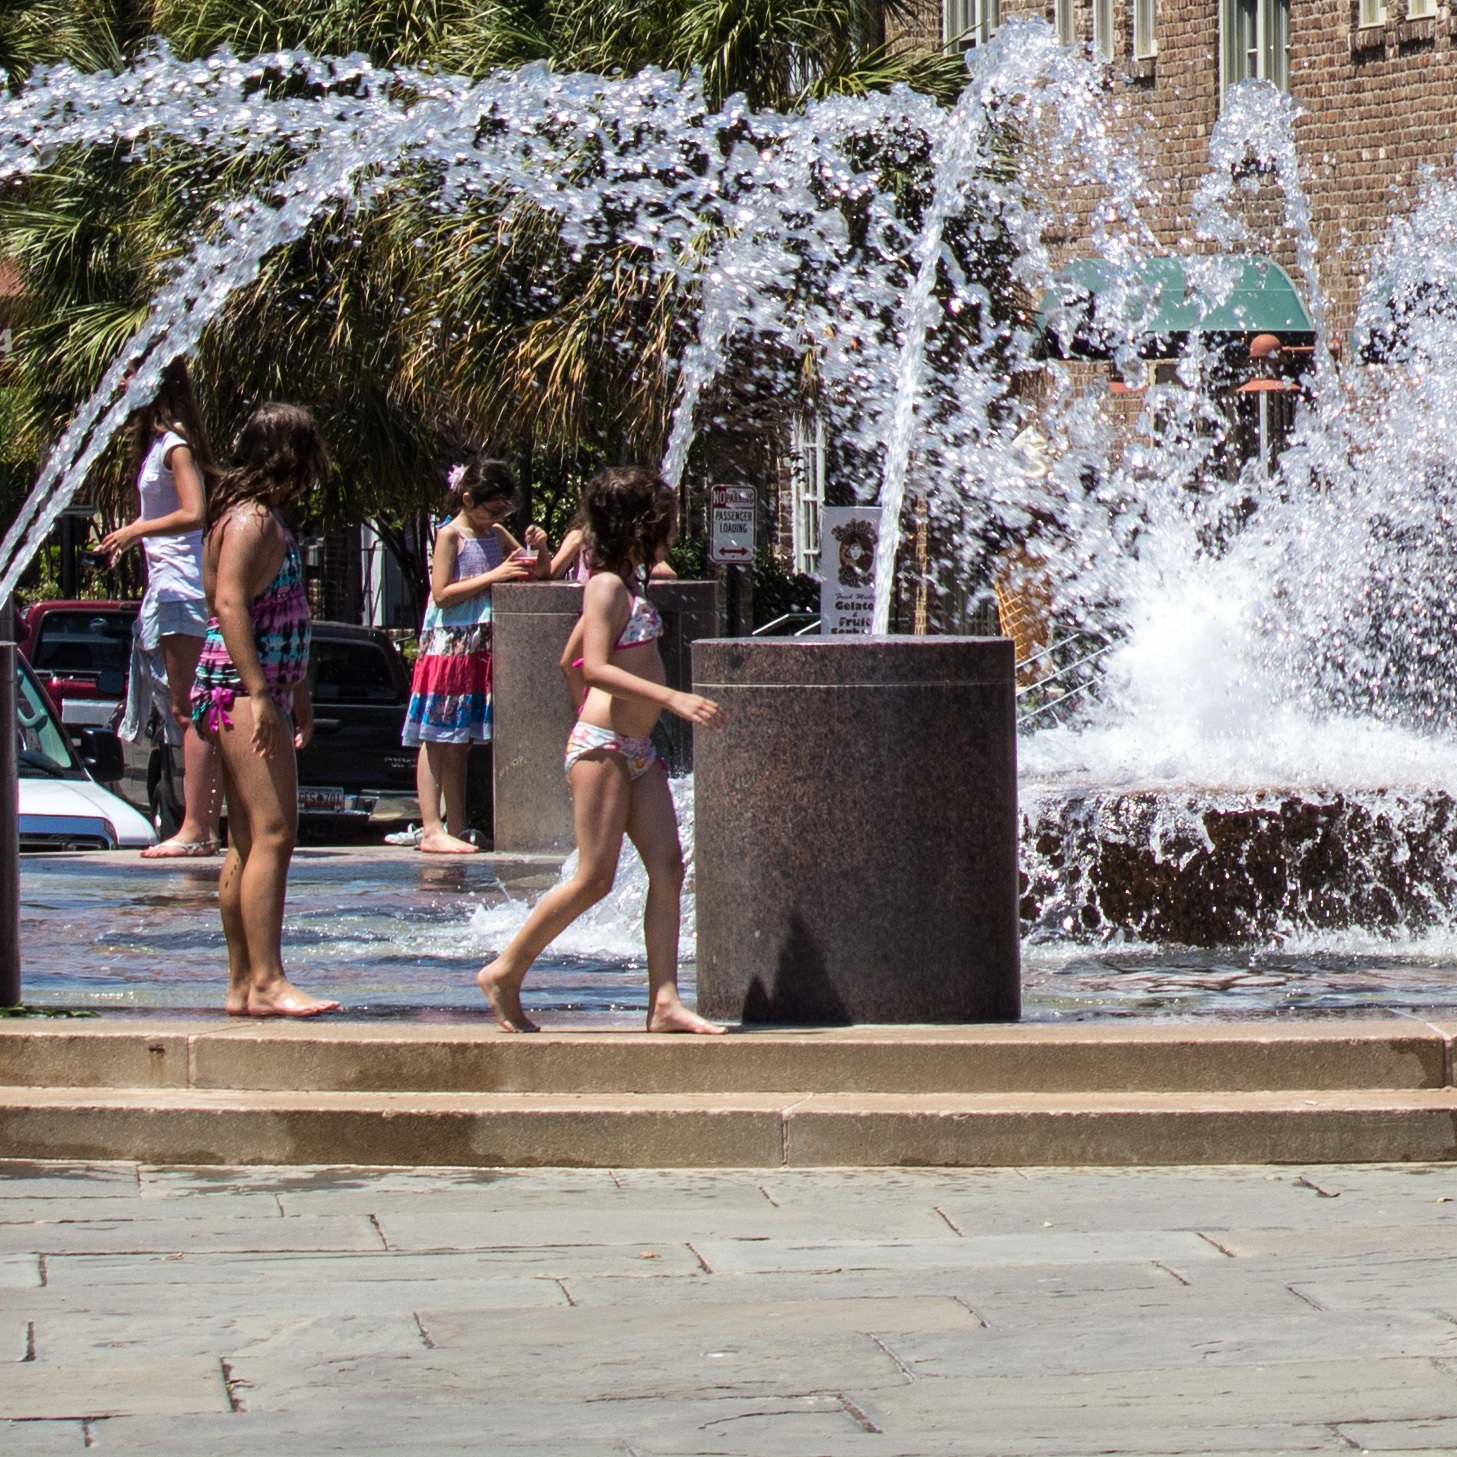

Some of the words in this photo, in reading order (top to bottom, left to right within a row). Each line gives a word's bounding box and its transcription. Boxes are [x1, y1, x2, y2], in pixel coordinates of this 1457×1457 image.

[713, 490, 726, 505] NO
[726, 492, 754, 504] PARKG
[715, 511, 753, 521] PASSENGER
[720, 523, 748, 533] LOADING
[835, 601, 874, 610] Gelato
